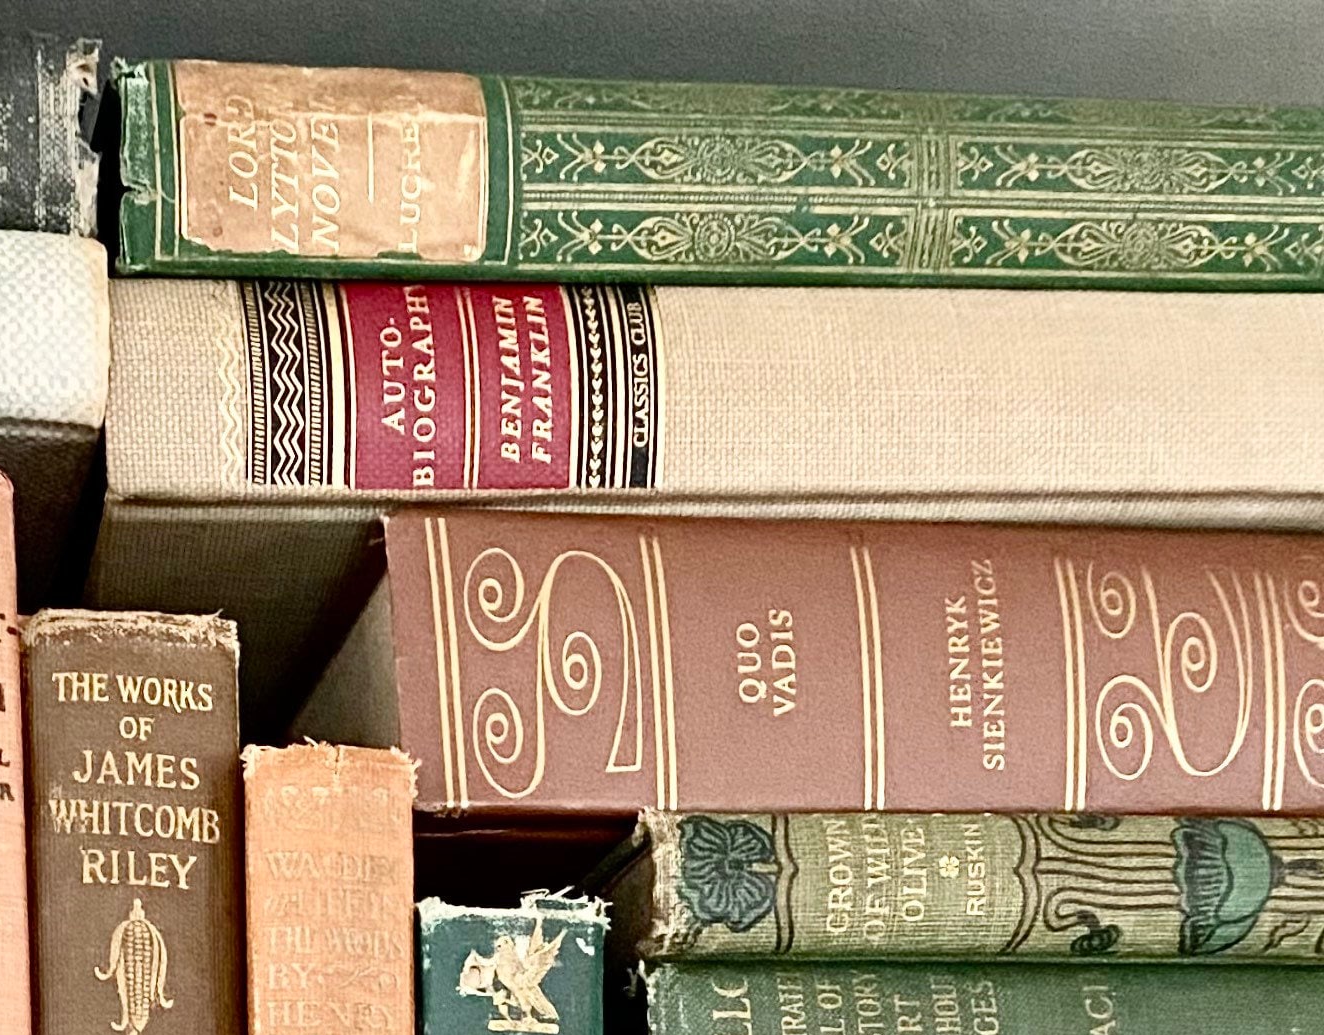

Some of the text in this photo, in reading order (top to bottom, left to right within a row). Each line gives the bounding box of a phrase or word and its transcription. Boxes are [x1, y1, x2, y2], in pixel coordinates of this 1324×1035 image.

[227, 94, 260, 211] LORD
[380, 317, 406, 436] AUTO-
[491, 295, 524, 464] BENJAMIN
[523, 295, 554, 465] FRANKLIN
[627, 301, 650, 448] CLASSICS CLUB
[52, 671, 214, 714] THE WORKS
[736, 622, 767, 704] QUO
[768, 608, 797, 718] VADIS
[944, 594, 974, 728] HENRYK
[971, 559, 1006, 772] SIENKIEWICZ
[72, 749, 201, 791] JAMES
[118, 716, 156, 741] OF
[48, 798, 221, 844] WHITCOMB
[78, 847, 198, 890] RILEY
[964, 822, 997, 916] RUSKIN
[823, 819, 853, 935] CROWN
[863, 893, 890, 944] OF
[815, 981, 843, 1010] OF
